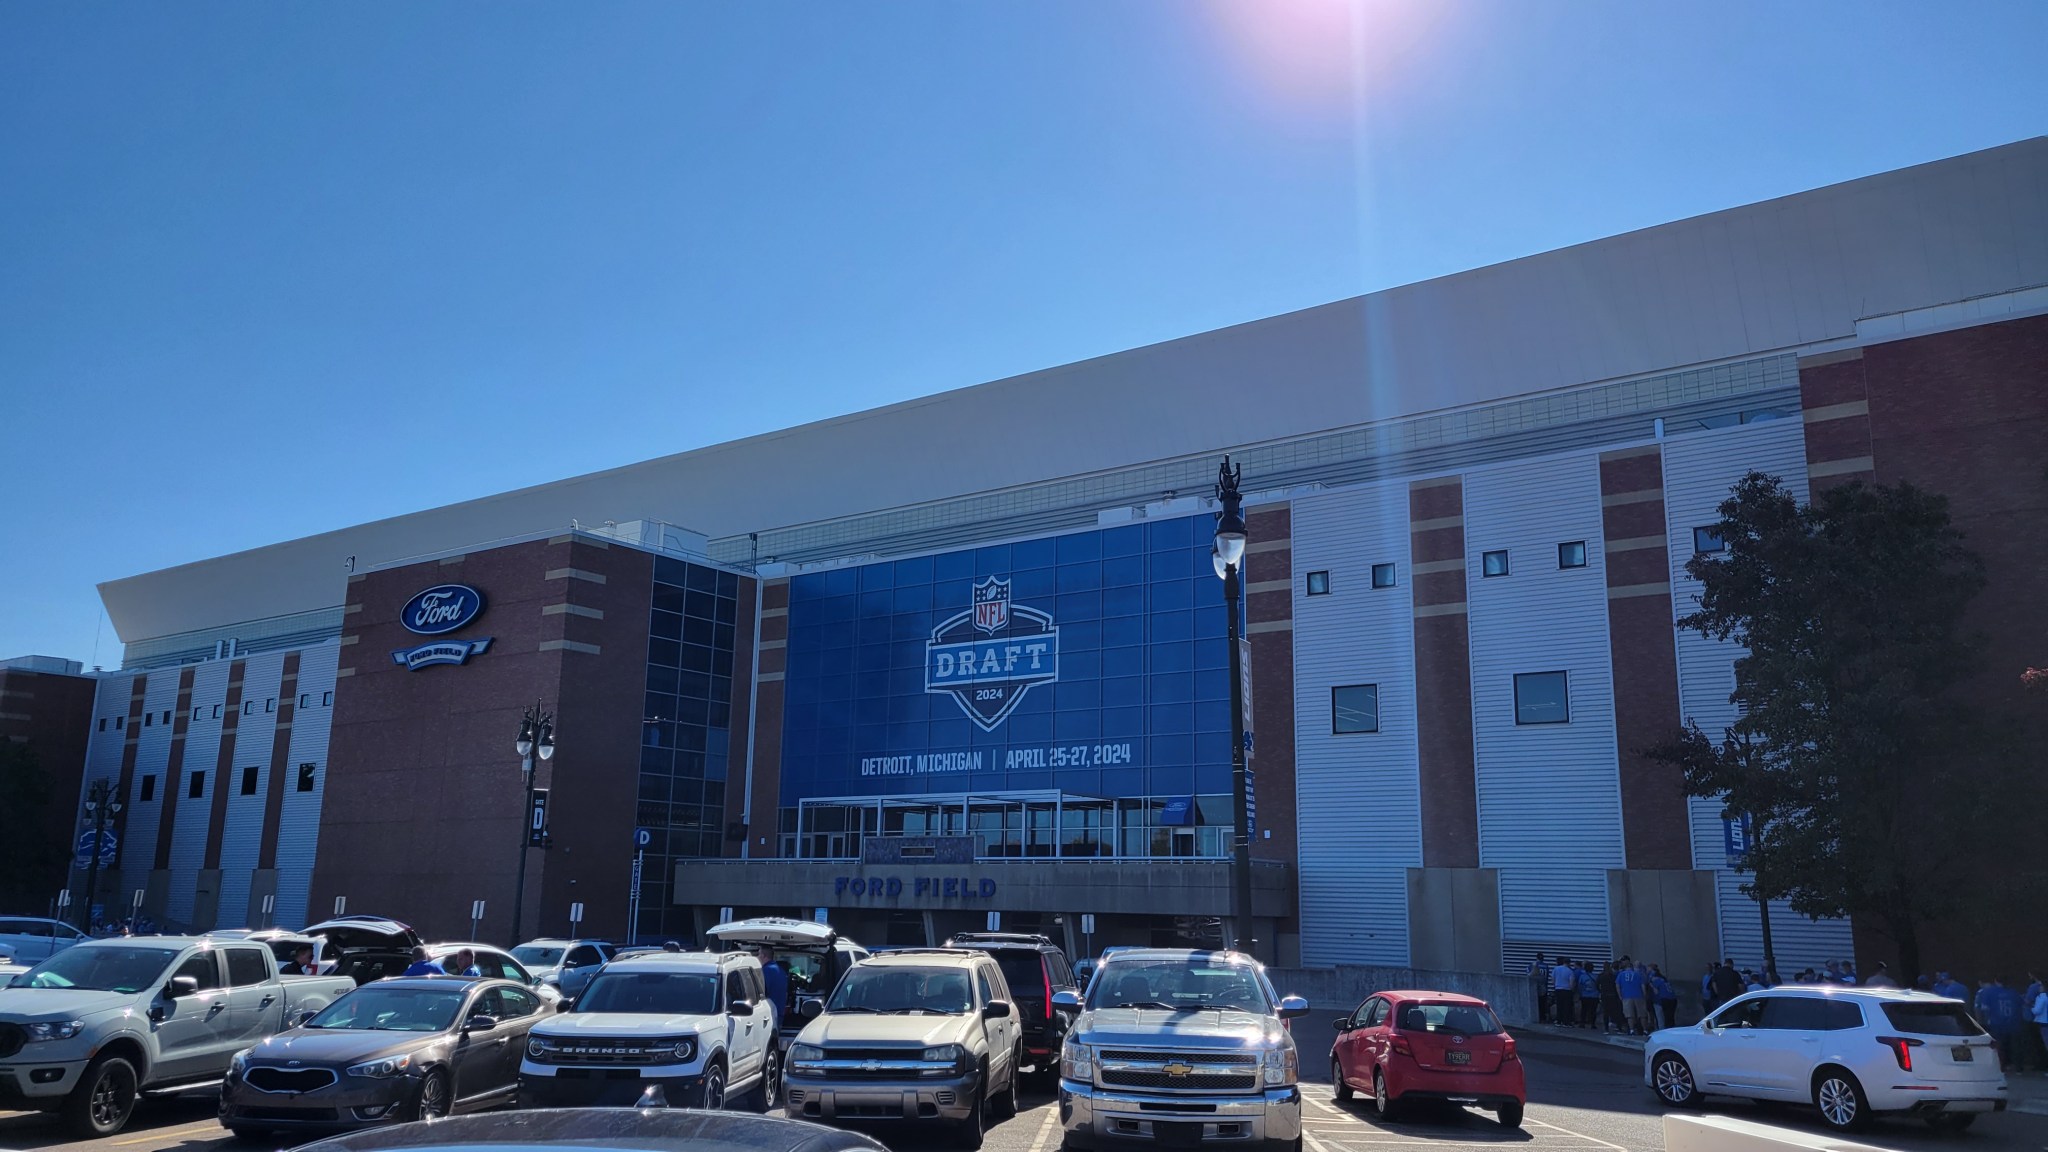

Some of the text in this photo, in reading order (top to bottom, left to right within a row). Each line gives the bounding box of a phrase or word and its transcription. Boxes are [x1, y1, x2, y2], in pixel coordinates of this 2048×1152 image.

[415, 591, 465, 626] Ford
[977, 602, 1005, 626] NFL
[935, 643, 1047, 678] DRAFT
[975, 688, 1004, 701] 2024
[861, 743, 1131, 776] DETROIT, MICHIGAN APRIL 25-27, 2024
[533, 807, 544, 830] D
[639, 830, 650, 845] D
[834, 876, 997, 898] FORD FIELD
